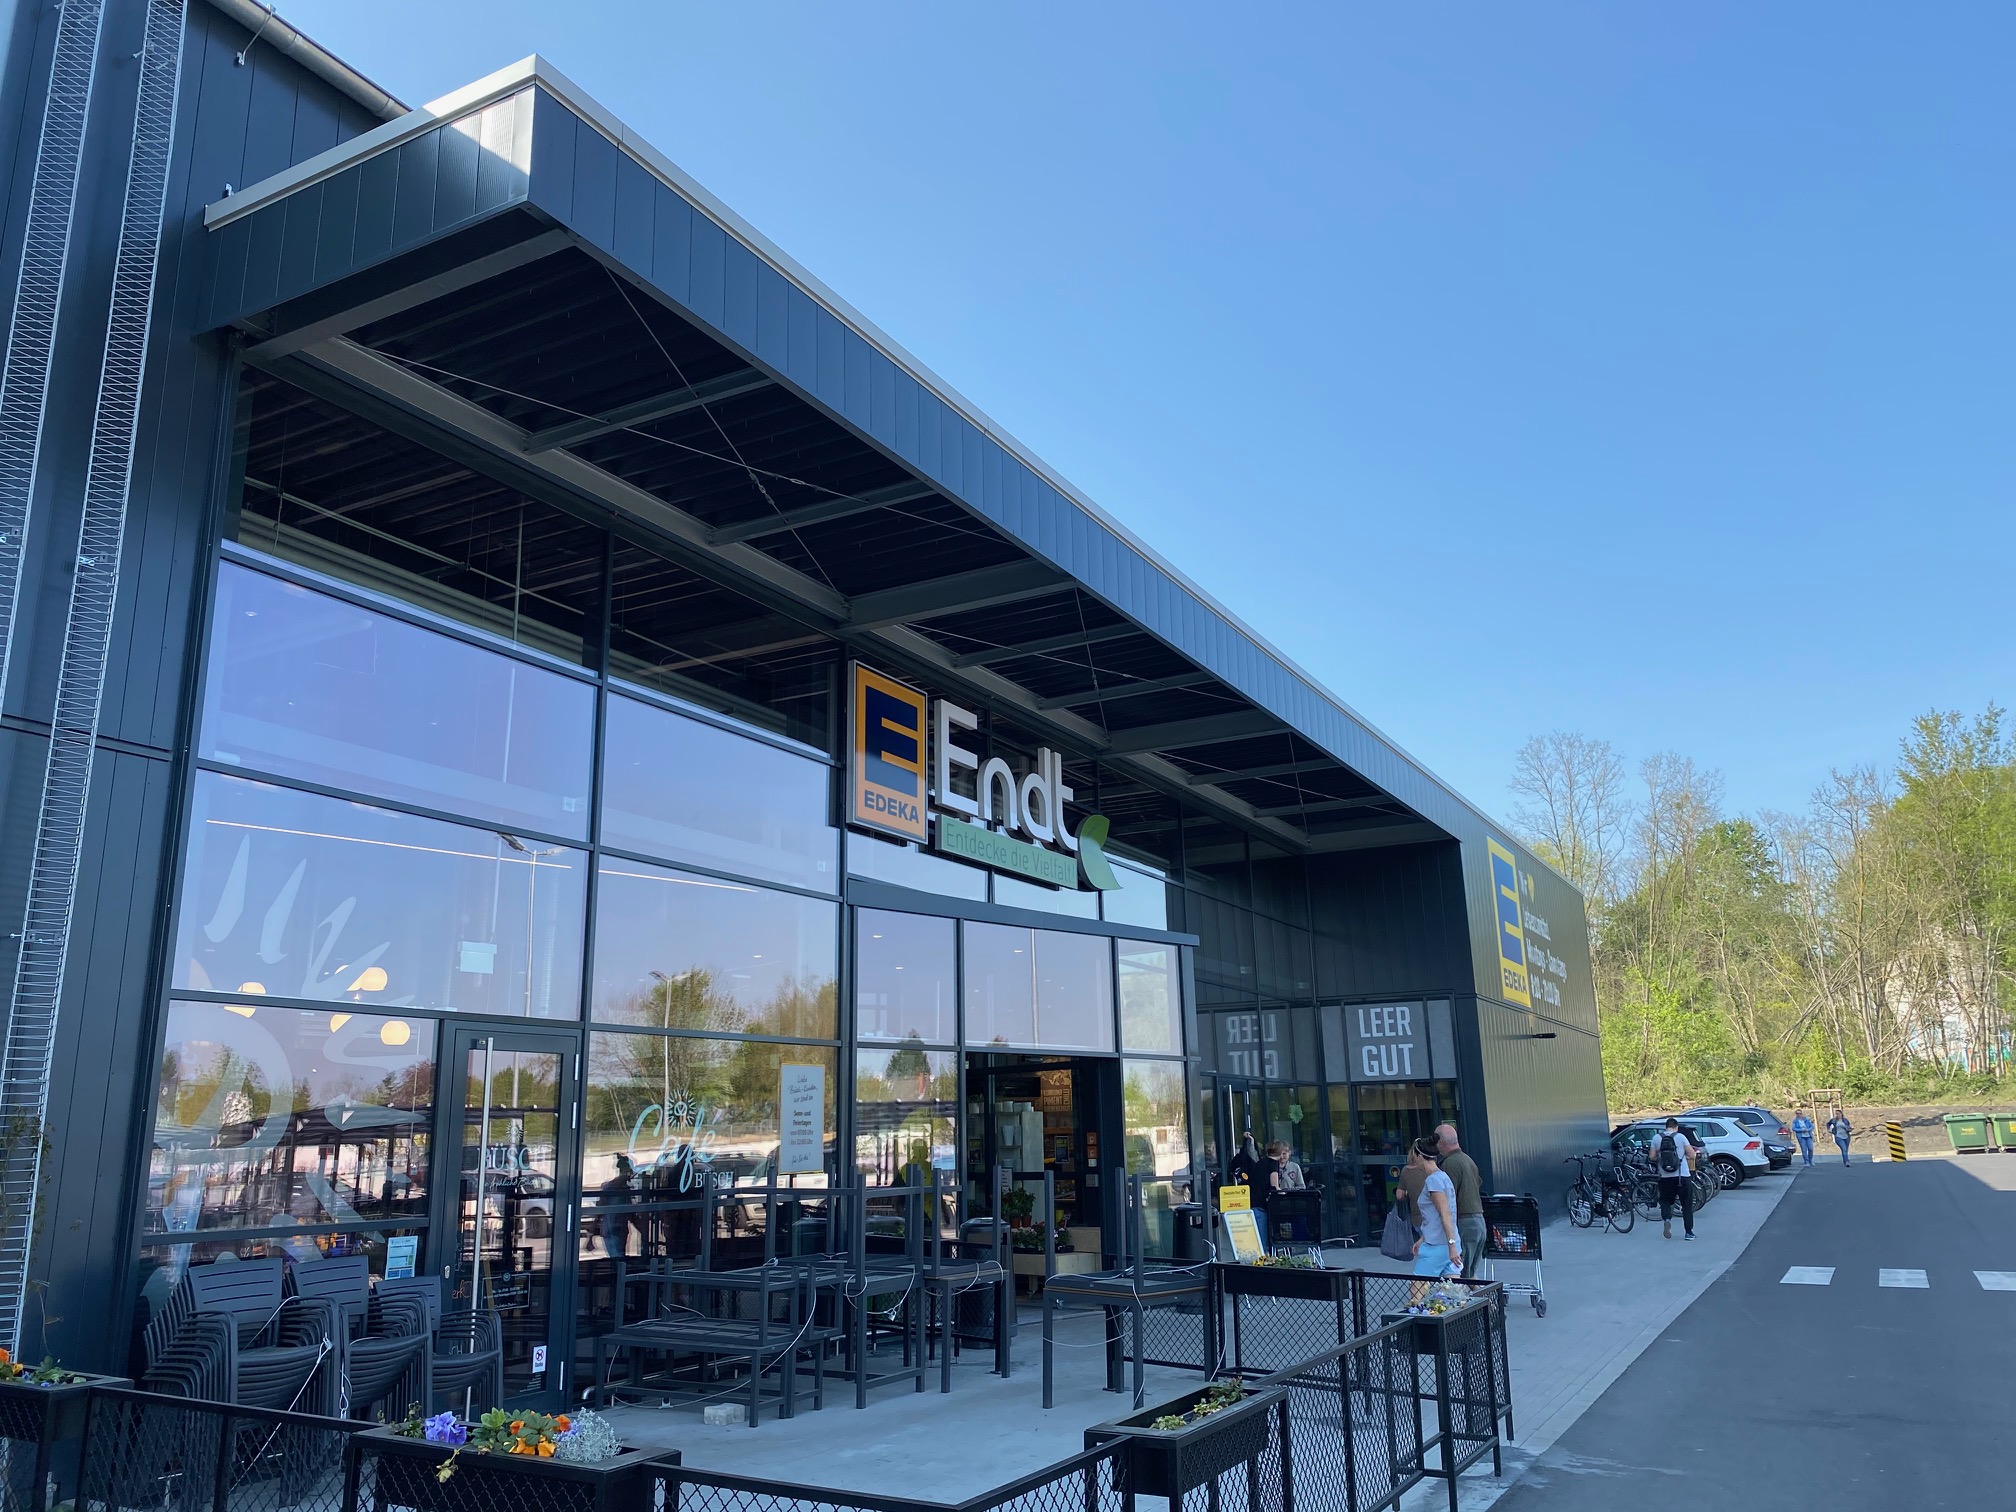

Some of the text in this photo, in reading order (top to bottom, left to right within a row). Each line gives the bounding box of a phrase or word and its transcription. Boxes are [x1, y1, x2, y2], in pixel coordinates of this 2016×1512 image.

[934, 698, 1078, 852] Endt
[864, 789, 920, 824] EDEKA
[946, 822, 1075, 884] Entdecke die Vielfalt!
[1503, 967, 1528, 995] EDEKA
[1358, 1006, 1413, 1038] LEER
[1362, 1043, 1414, 1077] GUT
[628, 1104, 724, 1193] Café
